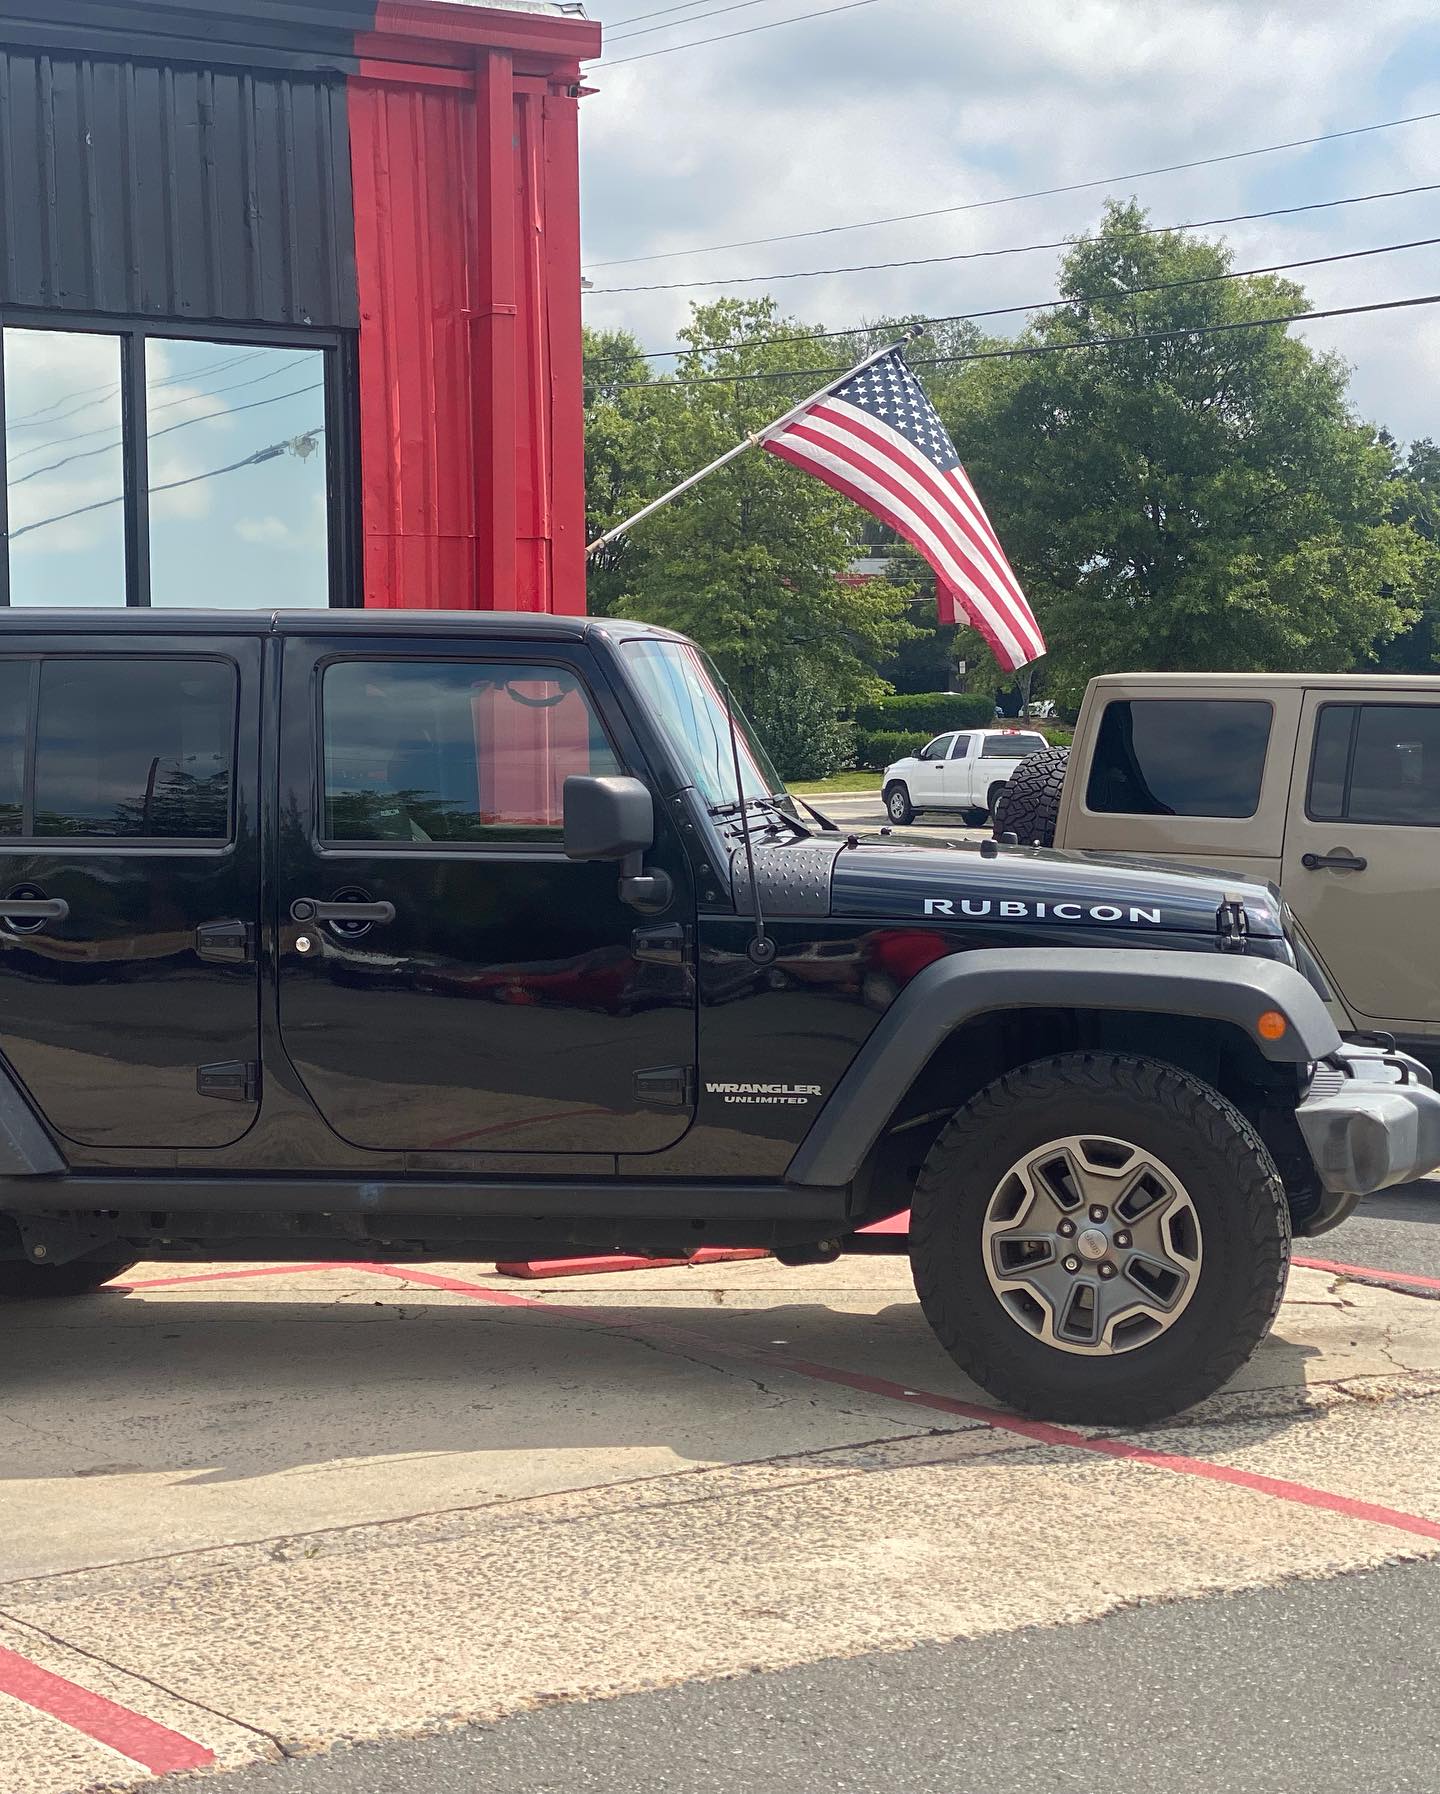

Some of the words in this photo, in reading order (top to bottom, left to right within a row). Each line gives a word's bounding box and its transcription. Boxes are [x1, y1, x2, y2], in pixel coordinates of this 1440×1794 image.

[923, 898, 1162, 924] RUBICON
[705, 1083, 823, 1096] WRANGLER
[724, 1096, 809, 1104] UNLIMITED
